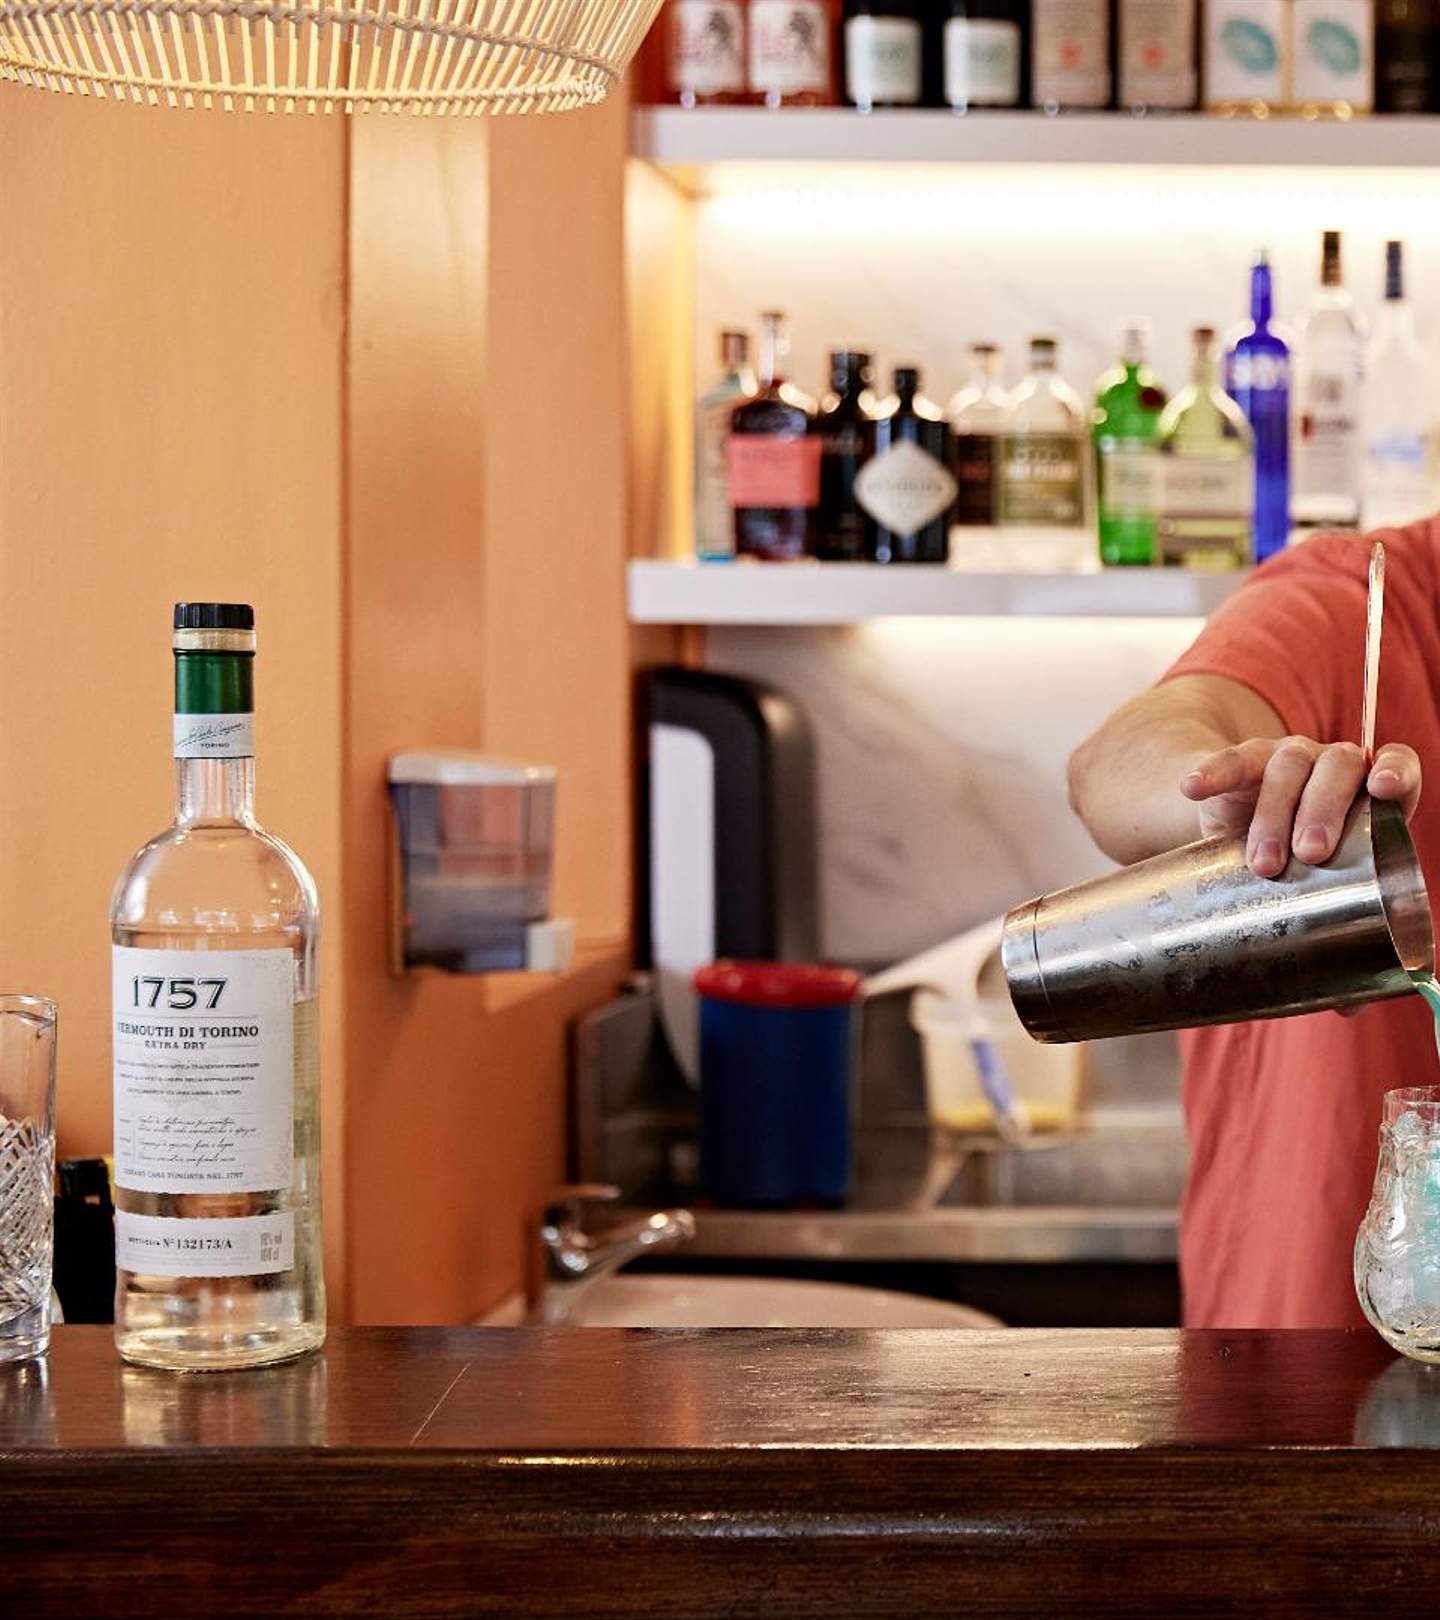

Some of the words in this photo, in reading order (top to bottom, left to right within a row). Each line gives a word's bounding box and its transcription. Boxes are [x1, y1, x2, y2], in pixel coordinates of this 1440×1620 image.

[132, 976, 228, 1010] 1757
[179, 1026, 194, 1038] DI
[199, 1025, 259, 1039] TORINO
[144, 1040, 179, 1050] EXTRA
[183, 1041, 207, 1050] DRY
[177, 1238, 233, 1250] 132173/A
